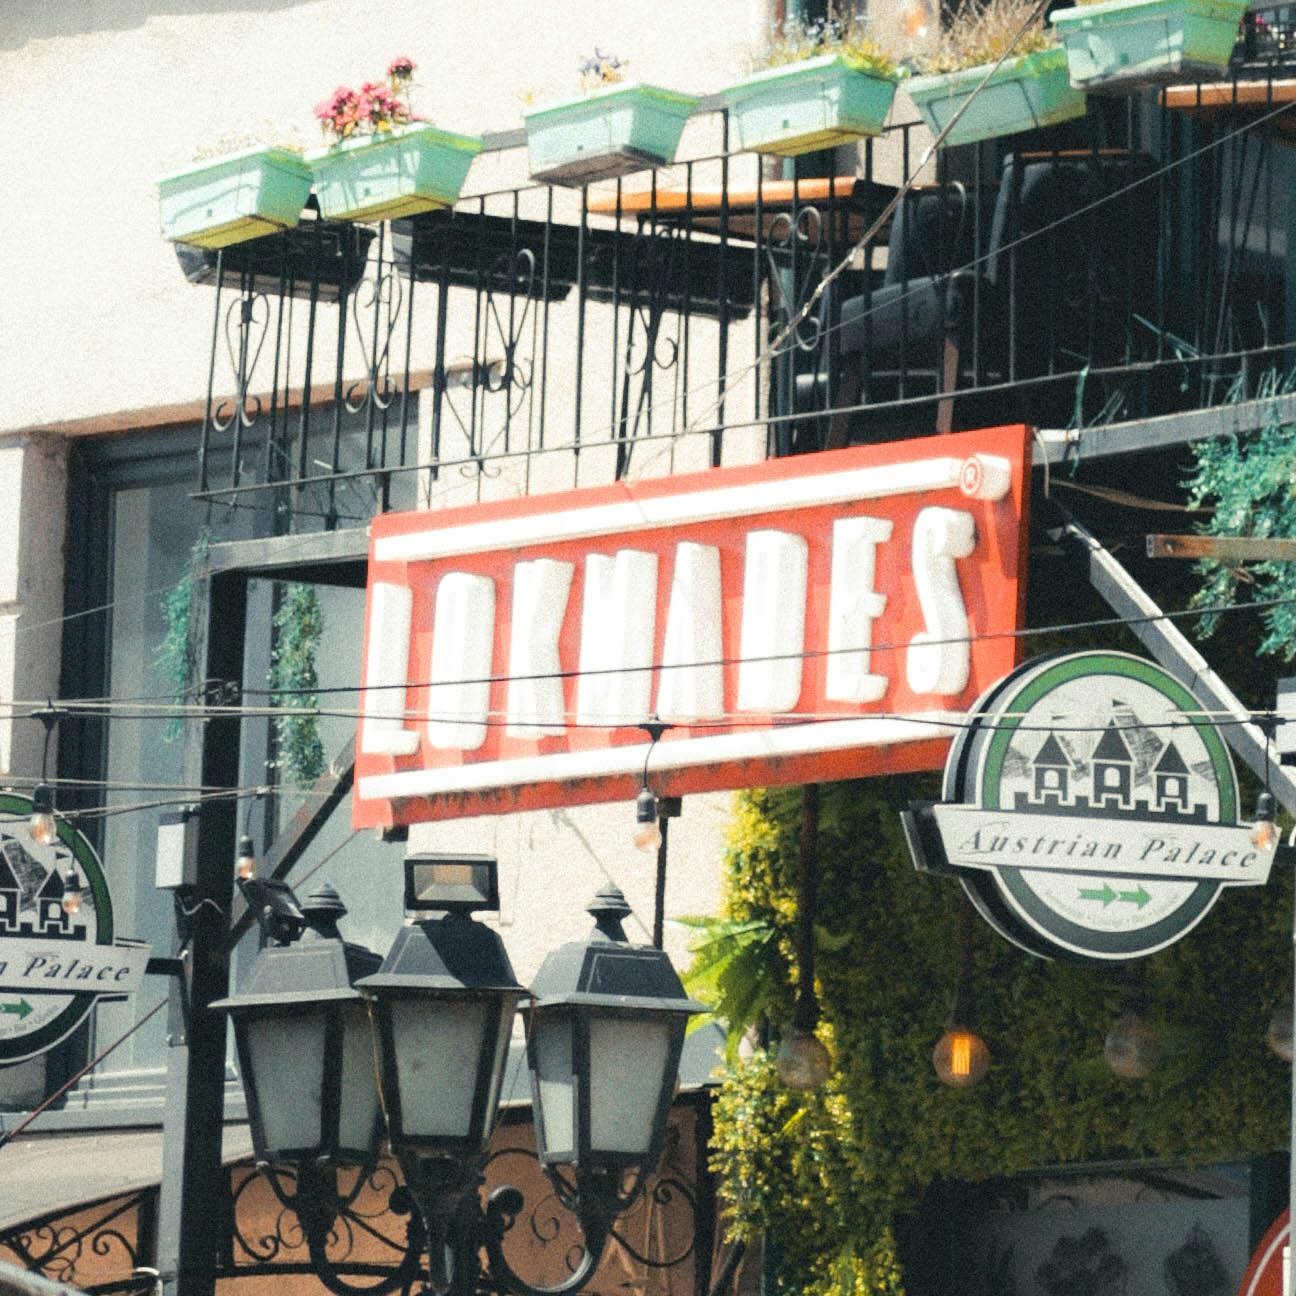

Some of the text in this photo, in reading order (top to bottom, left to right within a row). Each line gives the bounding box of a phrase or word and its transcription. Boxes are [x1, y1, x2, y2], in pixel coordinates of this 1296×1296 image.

[361, 506, 976, 756] LOKMADES
[958, 822, 1258, 869] Austrian Palace
[22, 955, 130, 981] Palace
